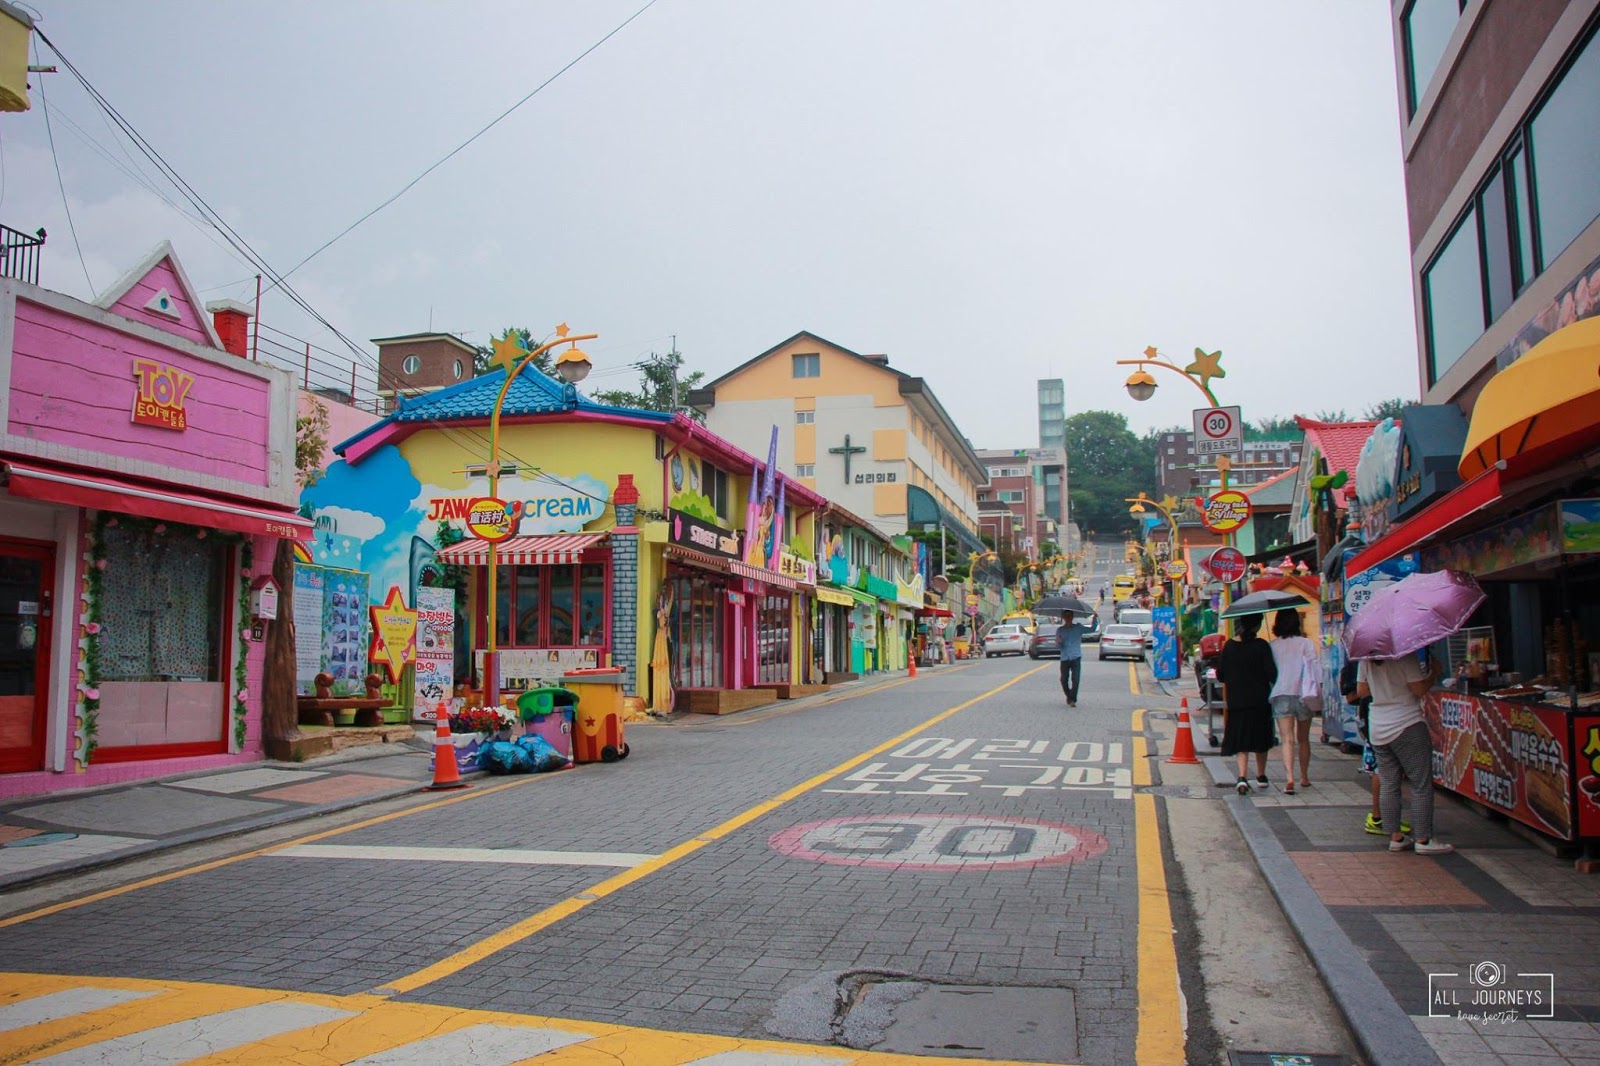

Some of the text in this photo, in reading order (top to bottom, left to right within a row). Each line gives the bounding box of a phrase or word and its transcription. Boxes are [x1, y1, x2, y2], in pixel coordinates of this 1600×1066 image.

[133, 359, 195, 411] TOY
[1210, 418, 1226, 431] 30
[428, 497, 475, 521] JAW
[469, 509, 505, 525] 童话村
[1207, 500, 1232, 512] Fairy
[1214, 510, 1248, 522] Village
[690, 524, 718, 550] STREET
[889, 737, 1123, 764] 어린이
[822, 762, 1133, 799] 보호구역
